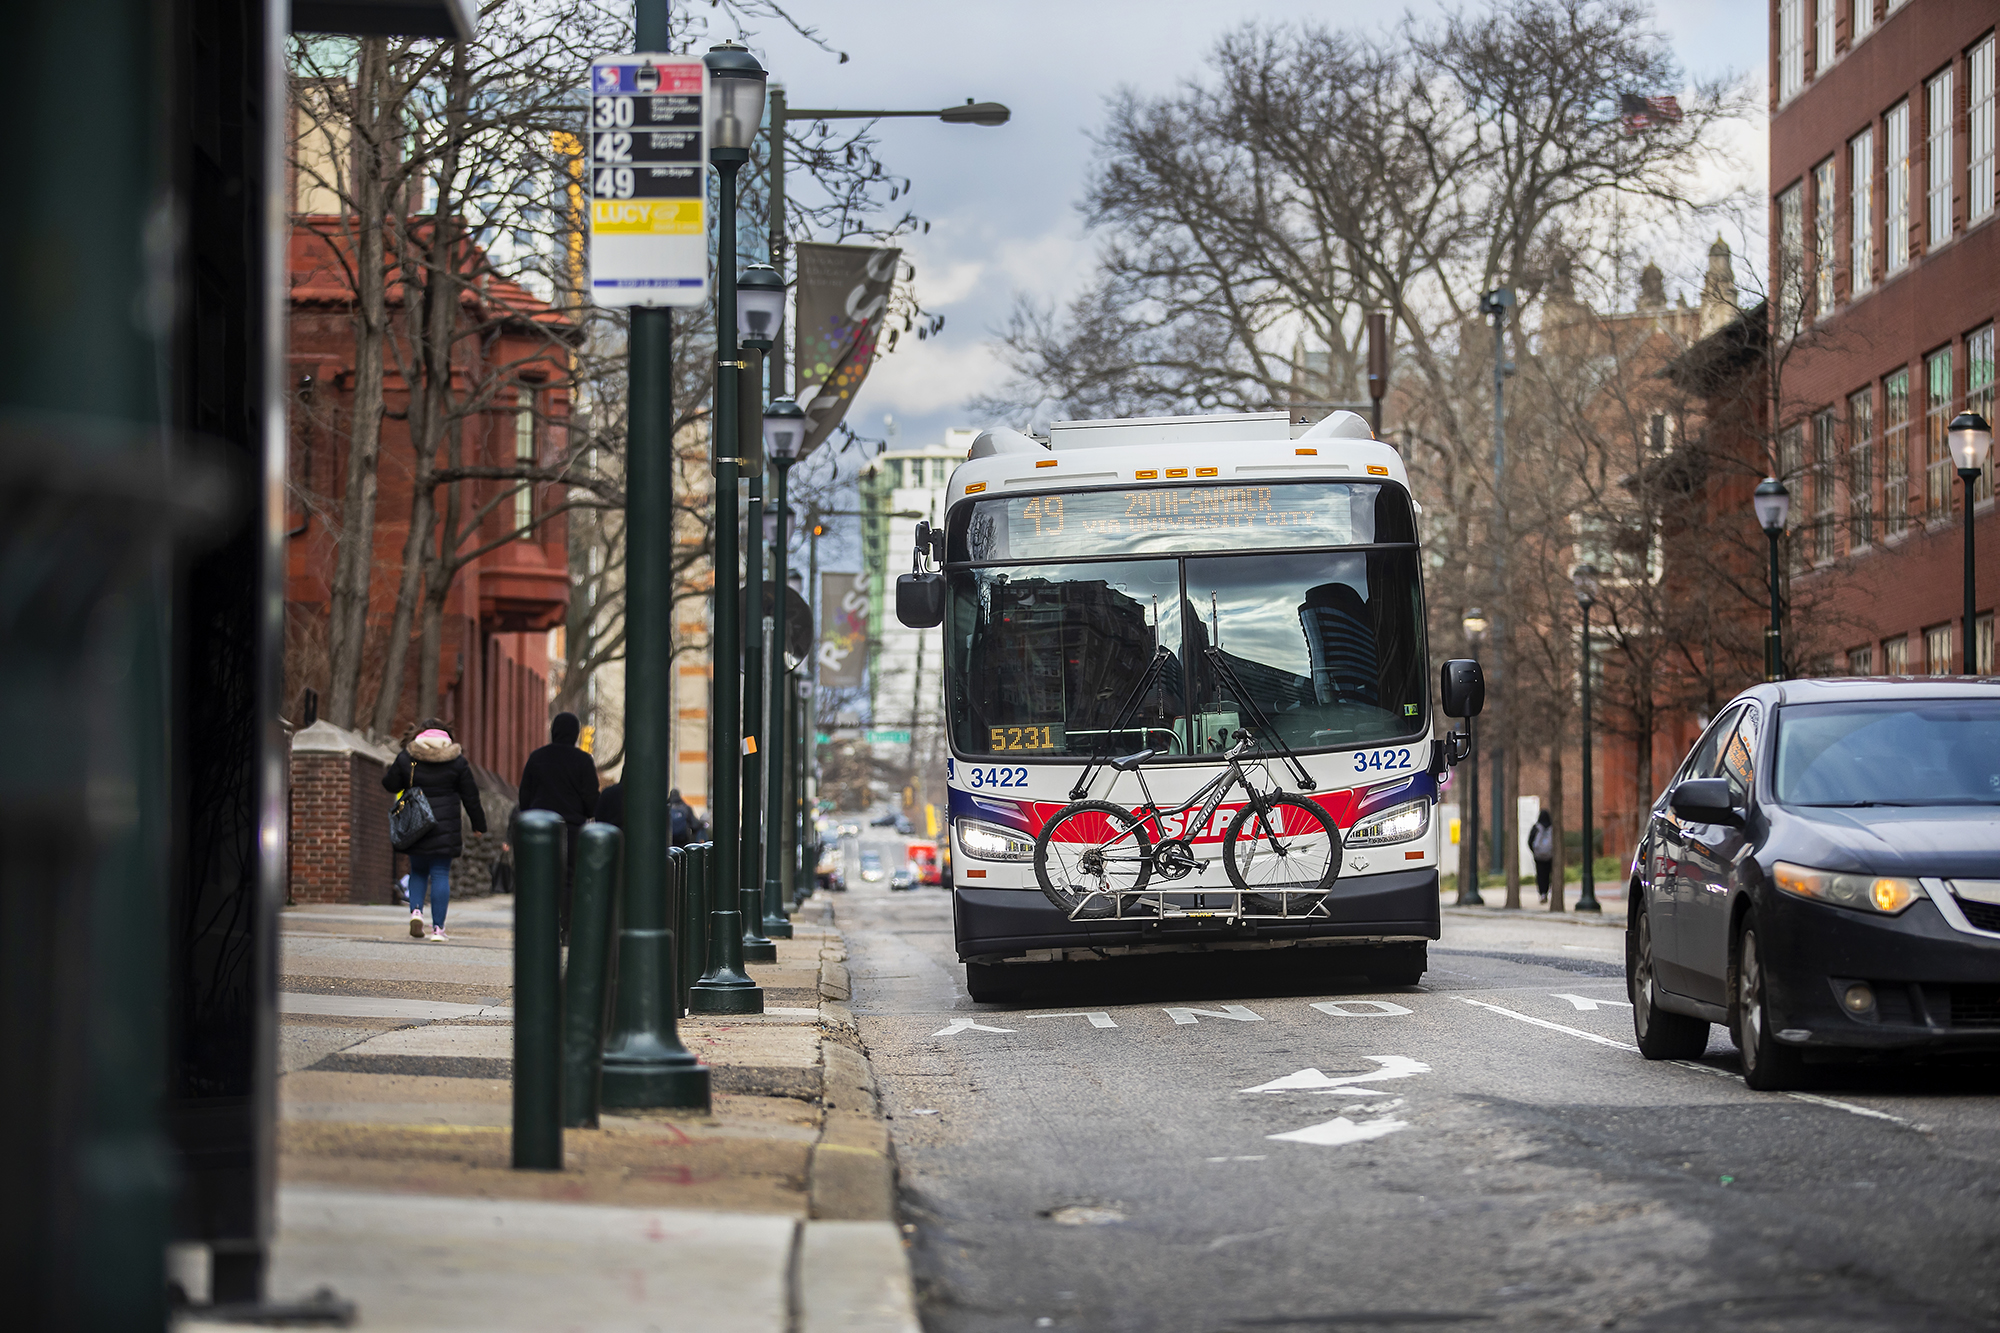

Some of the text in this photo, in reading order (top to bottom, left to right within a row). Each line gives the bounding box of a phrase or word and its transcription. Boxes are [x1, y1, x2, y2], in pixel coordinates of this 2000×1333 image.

[594, 97, 635, 129] 30
[594, 132, 634, 163] 42
[594, 168, 635, 199] 49
[596, 204, 653, 224] LUCY
[1023, 496, 1064, 536] 49
[1124, 487, 1272, 517] 29TH-SNYDER
[1082, 510, 1315, 534] VIA UNIVERSITY CITY
[991, 726, 1054, 751] 5231
[1353, 748, 1411, 772] 3422
[970, 767, 1029, 788] 3422
[1193, 784, 1227, 832] Raleigh
[931, 1000, 1414, 1037] ONLY
